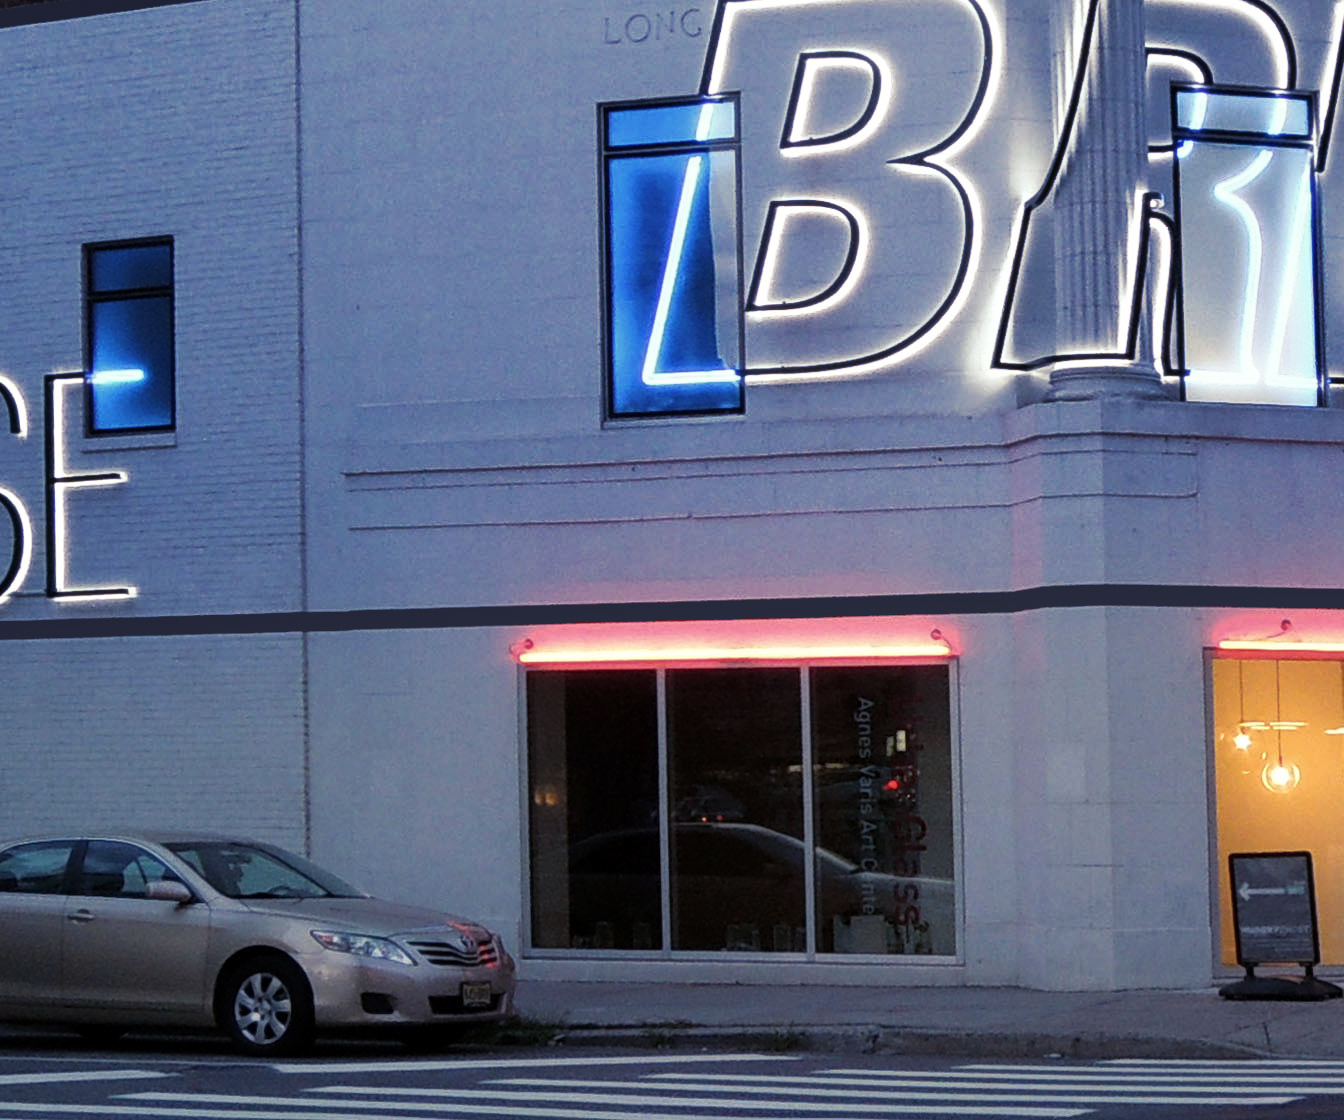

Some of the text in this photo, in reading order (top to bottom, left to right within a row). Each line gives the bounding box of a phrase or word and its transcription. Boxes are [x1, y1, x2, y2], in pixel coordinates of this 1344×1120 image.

[854, 696, 879, 915] Agnes Varis Art Cnte
